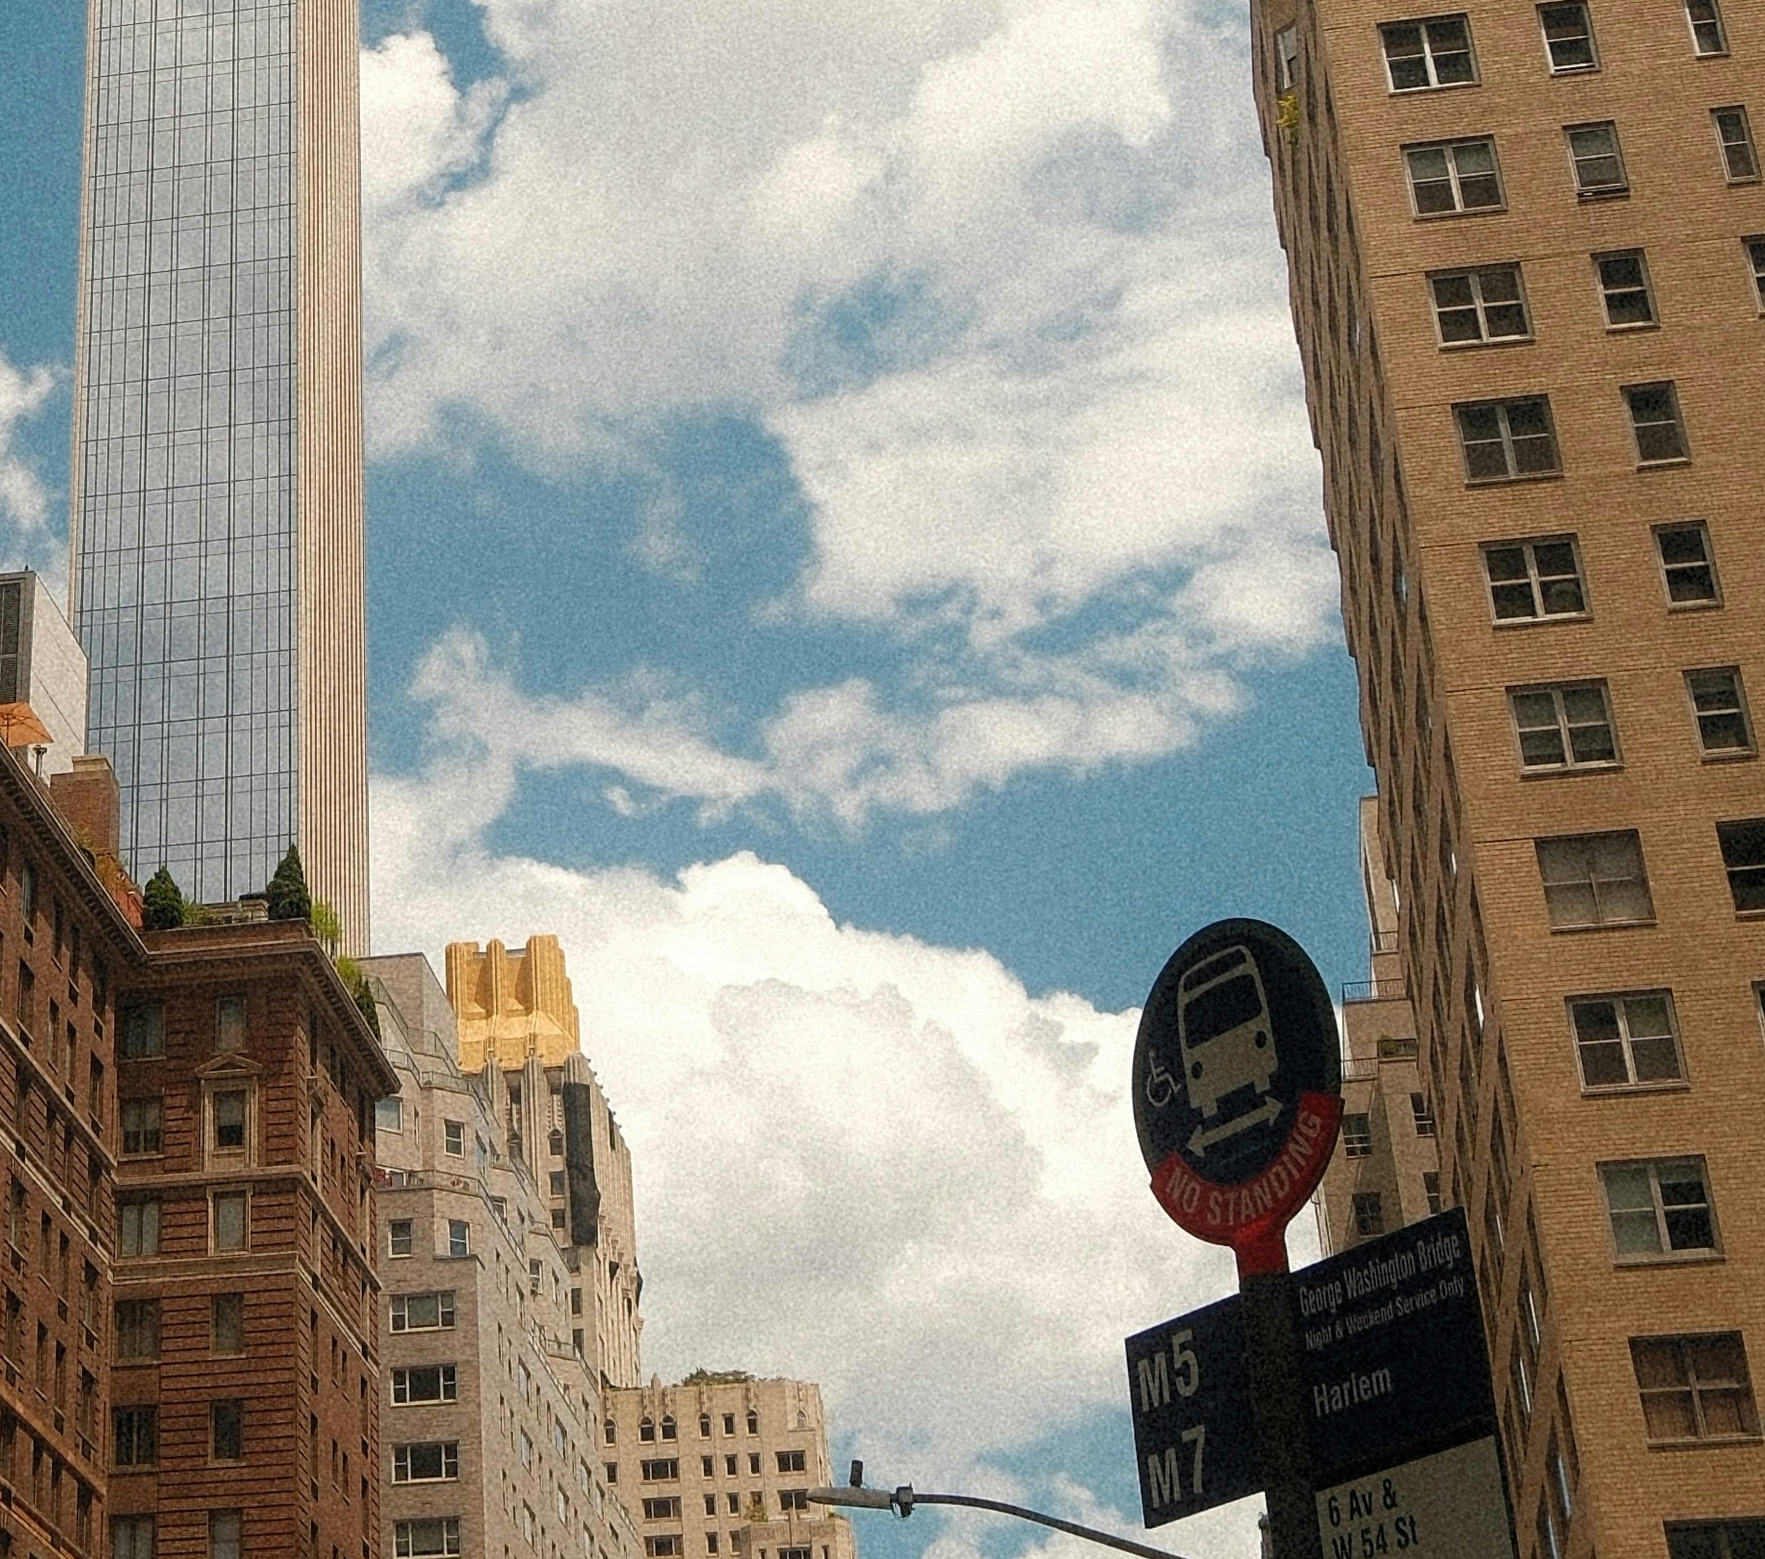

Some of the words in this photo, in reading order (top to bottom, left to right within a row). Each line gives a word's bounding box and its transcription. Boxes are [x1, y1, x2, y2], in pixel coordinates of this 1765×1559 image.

[1165, 1167, 1200, 1213] NO
[1206, 1111, 1323, 1226] STANDING
[1299, 1280, 1343, 1317] George
[1343, 1251, 1416, 1300] Washington
[1416, 1232, 1461, 1271] Bridge
[1304, 1324, 1332, 1351] Night
[1345, 1301, 1394, 1334] Weekend
[1395, 1288, 1437, 1316] Service
[1438, 1276, 1465, 1299] Only
[1137, 1329, 1200, 1413] M5
[1312, 1367, 1393, 1417] Harlem
[1147, 1423, 1206, 1509] M7
[1328, 1495, 1341, 1527] 6
[1349, 1489, 1373, 1521] Av
[1382, 1478, 1398, 1510] &
[1360, 1524, 1387, 1559] 54
[1394, 1515, 1418, 1550] St
